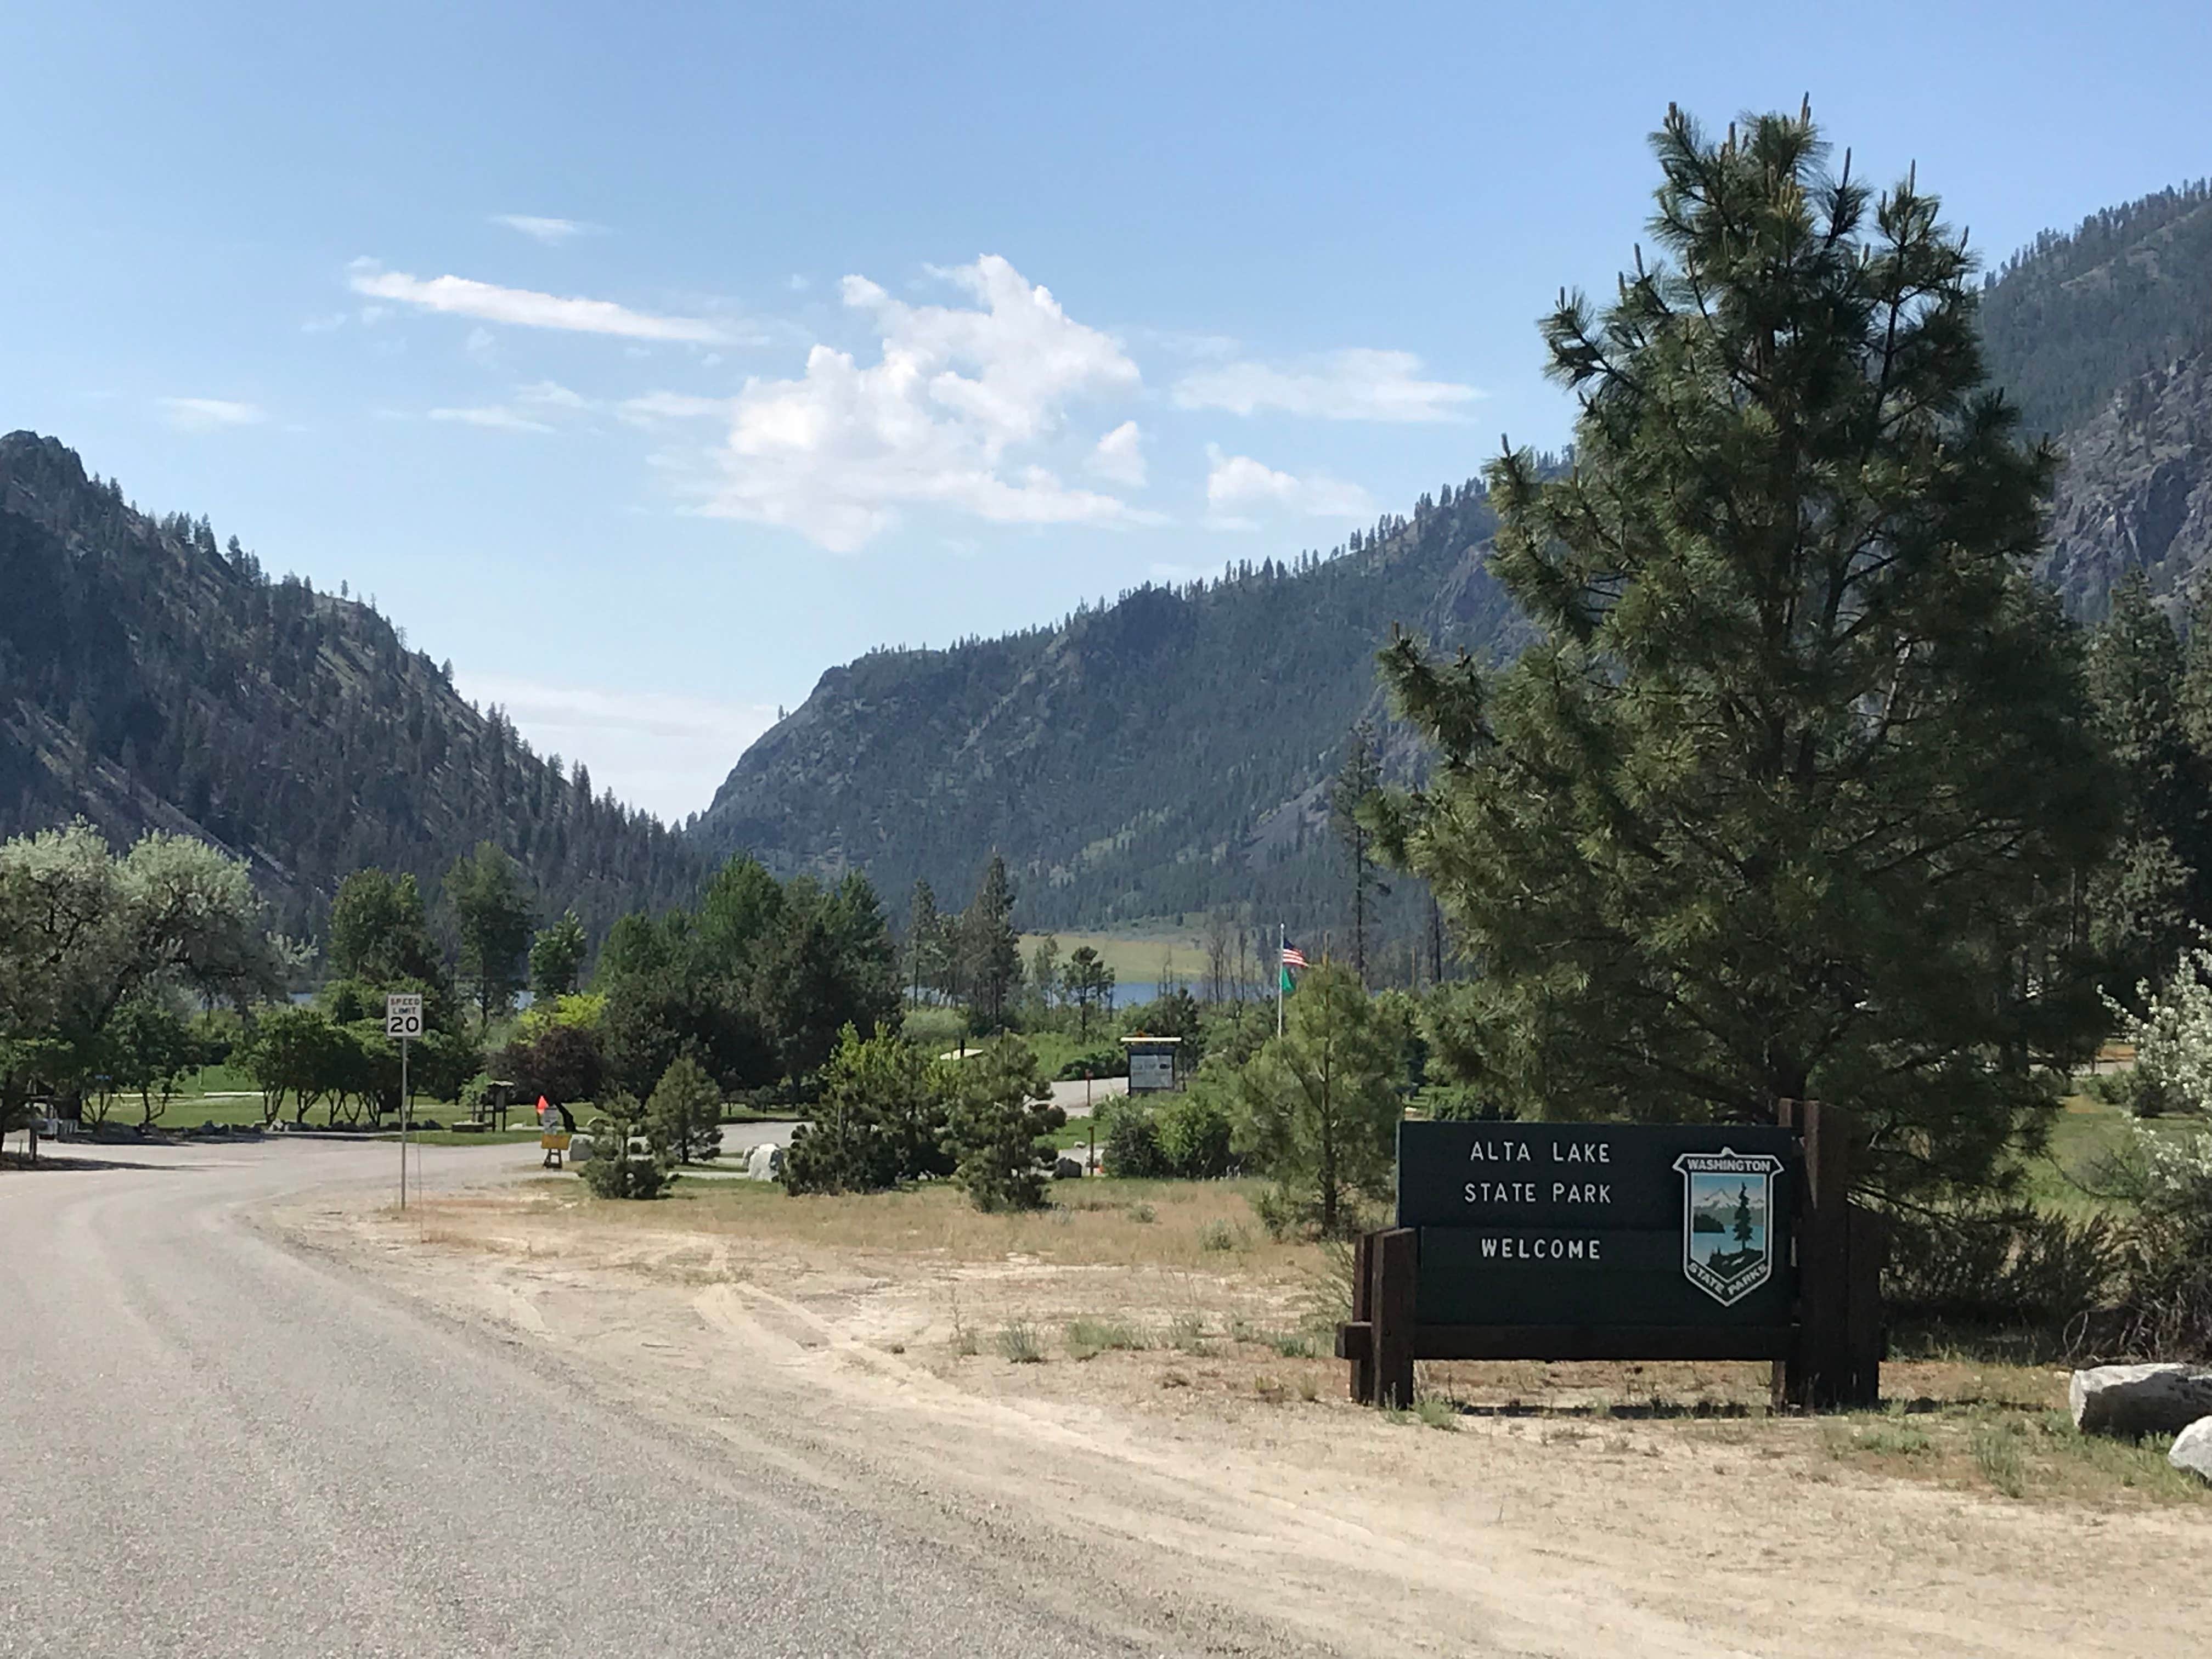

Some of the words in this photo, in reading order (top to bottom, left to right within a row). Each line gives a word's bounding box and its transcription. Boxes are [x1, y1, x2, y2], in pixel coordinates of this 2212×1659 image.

[390, 1016, 419, 1032] 20
[1470, 1141, 1531, 1161] ALTA
[1553, 1142, 1610, 1163] LAKE
[1687, 1159, 1770, 1171] WASHINGTON
[1464, 1183, 1536, 1203] STATE
[1553, 1182, 1611, 1203] PARK
[1482, 1238, 1600, 1259] WELCOME
[1688, 1262, 1725, 1294] STATE
[1728, 1263, 1768, 1295] PARKS
